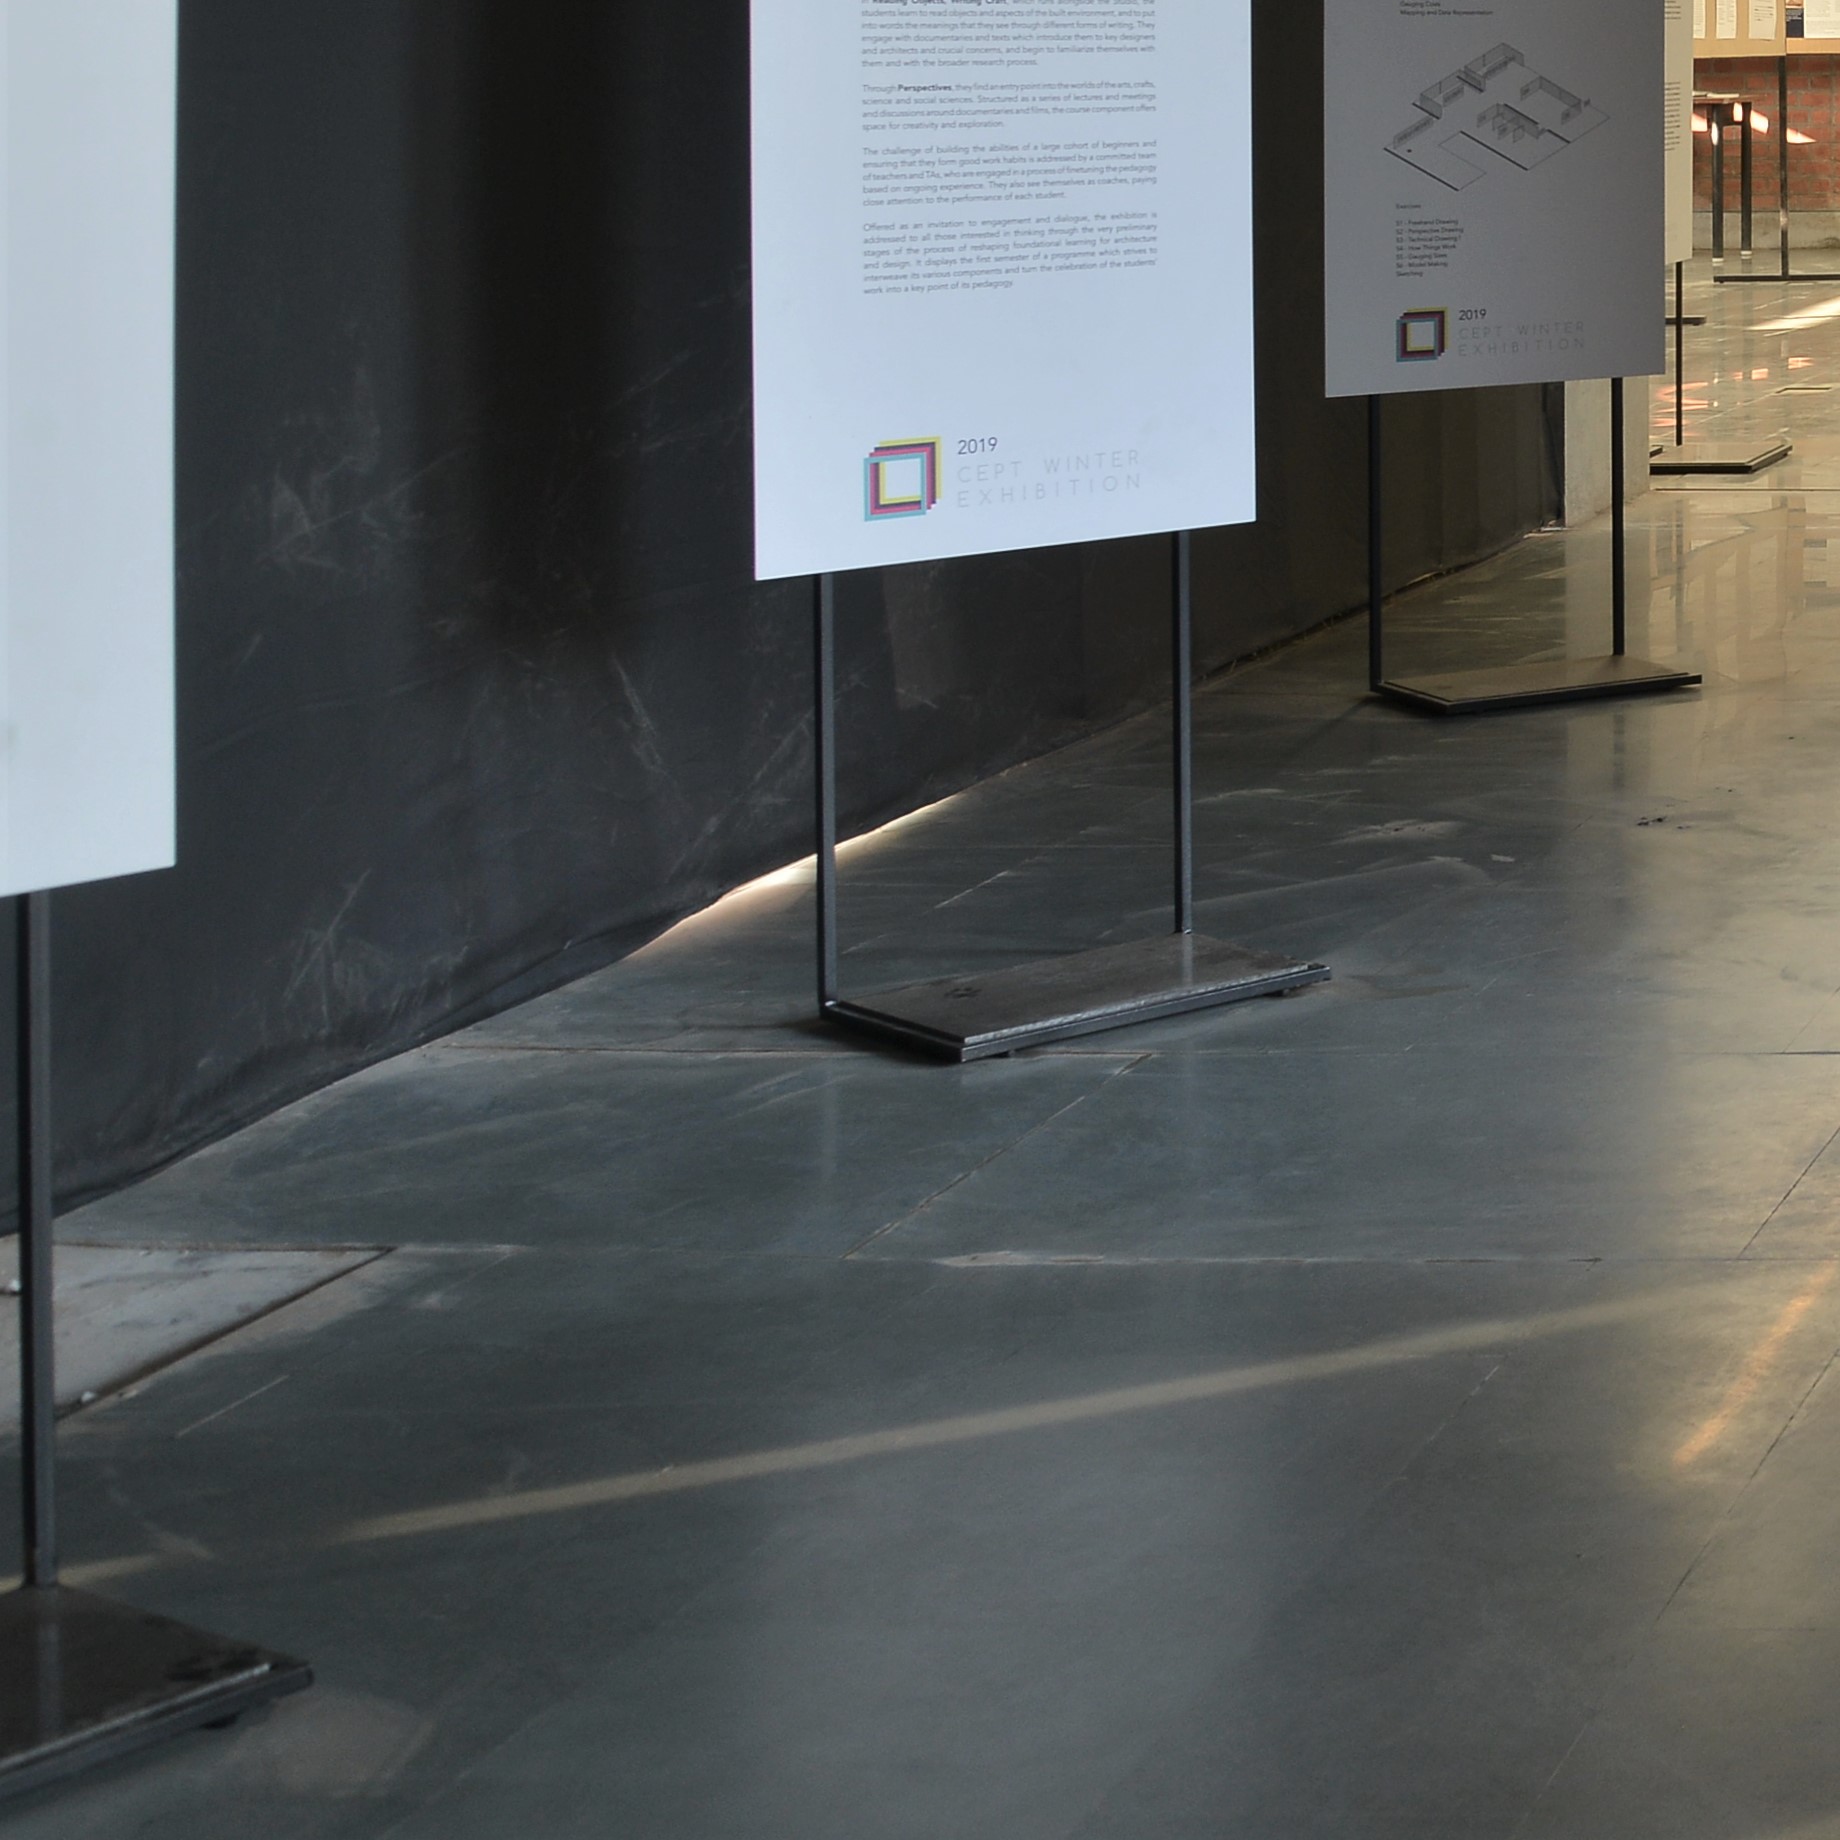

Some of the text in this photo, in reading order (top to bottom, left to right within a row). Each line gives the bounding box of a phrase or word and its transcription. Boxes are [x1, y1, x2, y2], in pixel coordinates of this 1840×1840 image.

[1459, 309, 1486, 320] 2019
[957, 437, 998, 455] 2019
[957, 449, 1140, 483] CEPT WINTER
[958, 473, 1141, 508] EXHIBITION
